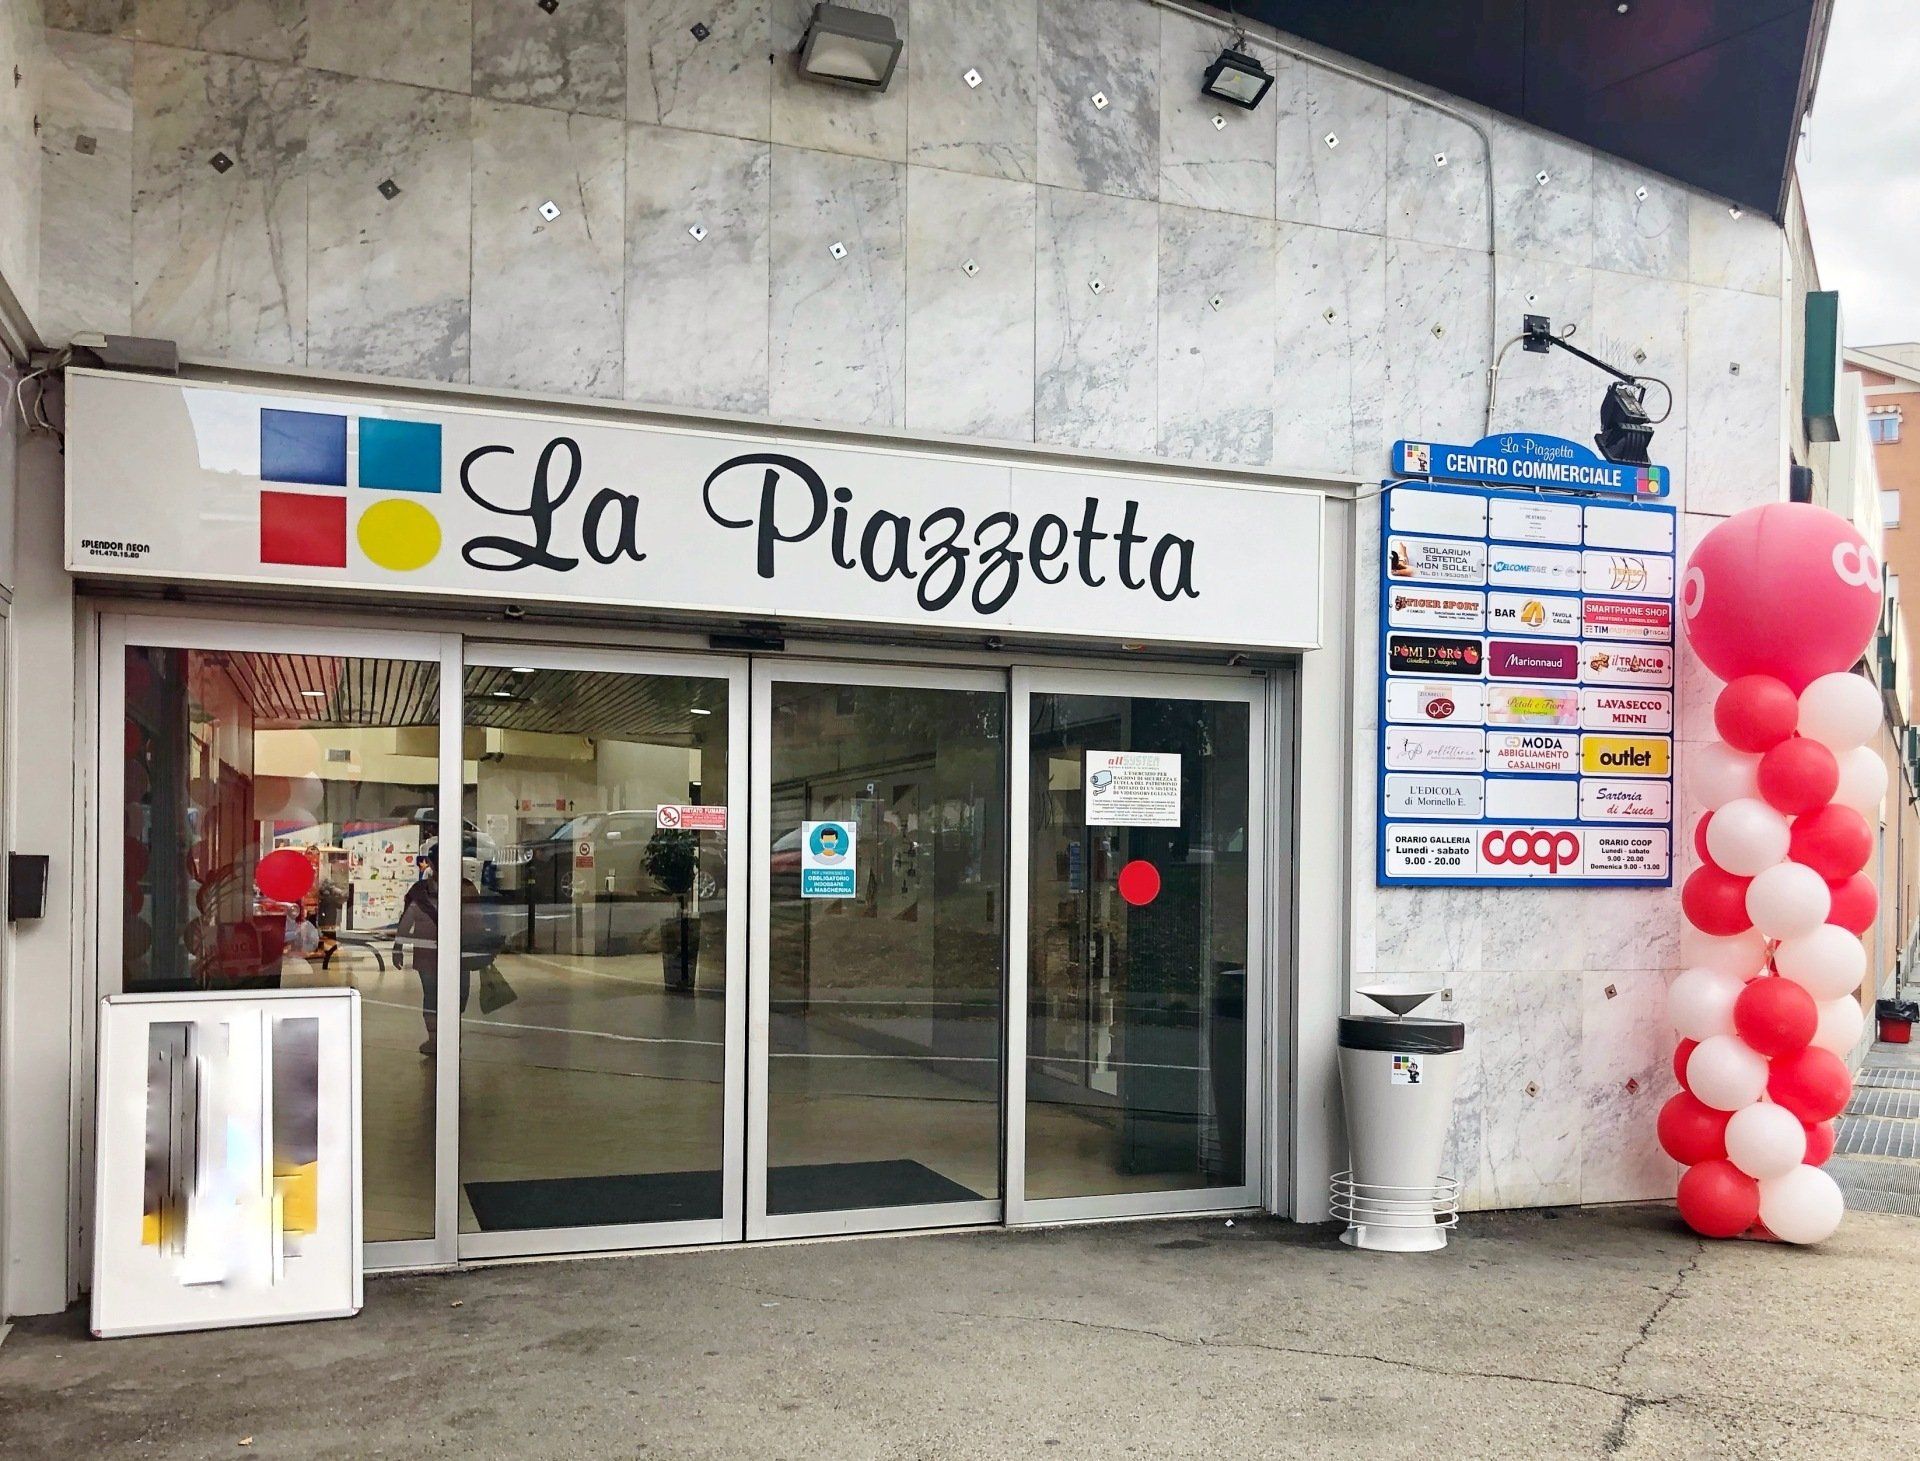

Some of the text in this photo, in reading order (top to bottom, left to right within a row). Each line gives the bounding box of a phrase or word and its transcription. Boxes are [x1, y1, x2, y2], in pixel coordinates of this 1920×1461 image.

[1500, 436, 1574, 462] La Piazzetta
[1446, 453, 1622, 487] CENTRO COMMERCIALE
[459, 436, 1200, 615] La Piazzetta
[81, 539, 150, 553] SPLENDOR NEON
[1422, 547, 1471, 556] SOLARIUM
[1425, 555, 1468, 564] ESTETICA
[1416, 562, 1477, 572] MON SOLEIL
[1406, 598, 1479, 611] TIGER SPORT
[1494, 608, 1516, 618] BAR
[1586, 604, 1668, 617] SMARTPHONE SHOP
[1594, 625, 1609, 634] TIM
[1504, 653, 1563, 668] Marionnaud
[1597, 699, 1662, 711] LAVASECCO
[1612, 713, 1647, 724] MINNI
[1522, 737, 1563, 750] MODA
[1498, 749, 1569, 759] ABBIGLIAMENTO
[1600, 746, 1652, 767] outlet
[1507, 760, 1561, 770] CASALINGHI
[1410, 785, 1461, 796] L'EDICOLA
[1596, 788, 1642, 801] Sartoria
[1404, 797, 1413, 806] di
[1607, 803, 1654, 815] di Lucia
[1429, 836, 1471, 844] GALLERIA
[1437, 846, 1470, 855] sabato
[1481, 830, 1580, 874] coop
[1404, 857, 1426, 865] 9.00
[1434, 857, 1461, 866] 20.00
